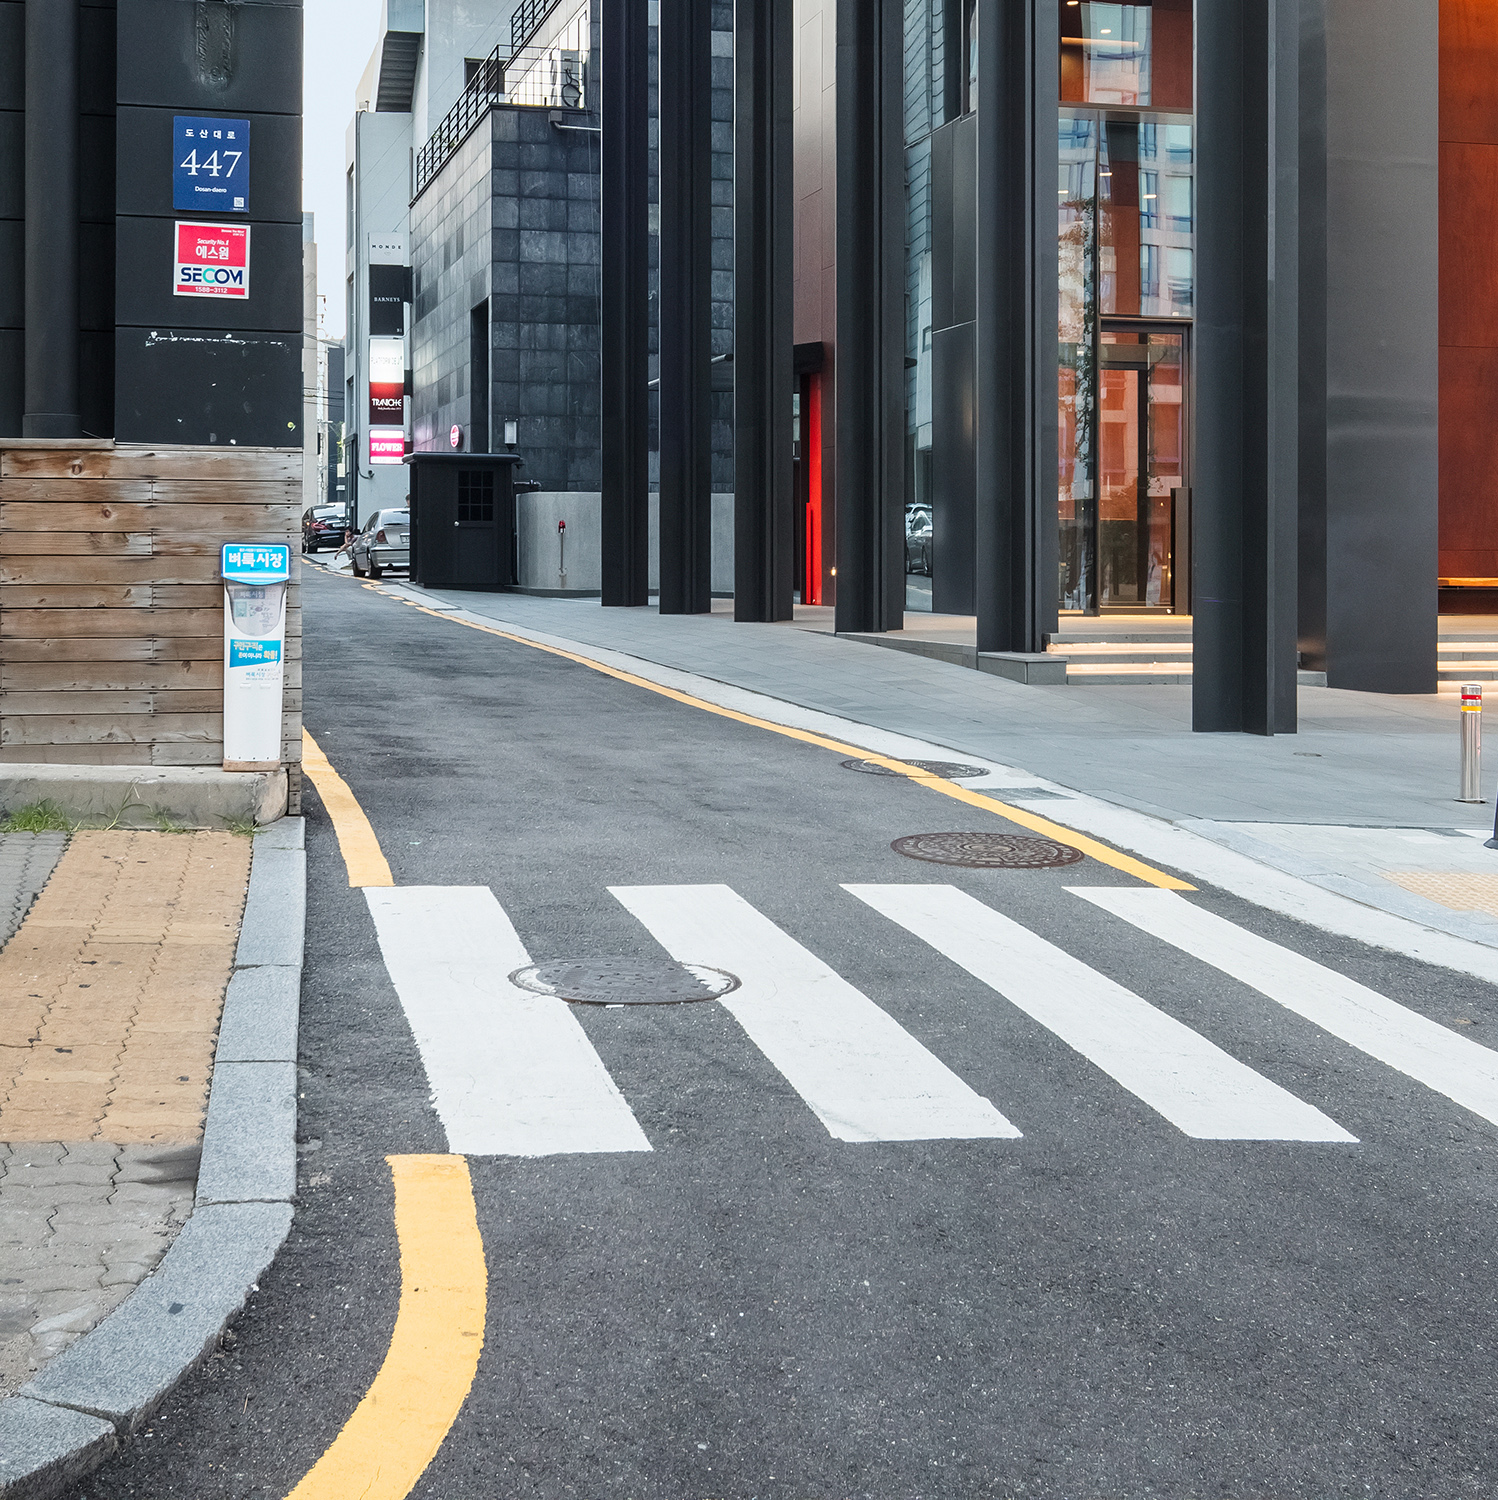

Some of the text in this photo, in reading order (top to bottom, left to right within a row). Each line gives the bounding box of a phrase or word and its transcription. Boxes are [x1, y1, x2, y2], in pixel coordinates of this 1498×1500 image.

[185, 128, 236, 140] 도산대로
[180, 148, 243, 178] 447
[194, 185, 228, 193] Dosan-daero
[196, 238, 217, 246] Security
[195, 245, 229, 260] 에스원
[181, 267, 243, 285] SECOM
[195, 286, 228, 294] 1588-3112
[371, 442, 403, 452] FLOWER
[228, 552, 284, 568] 벼룩시장
